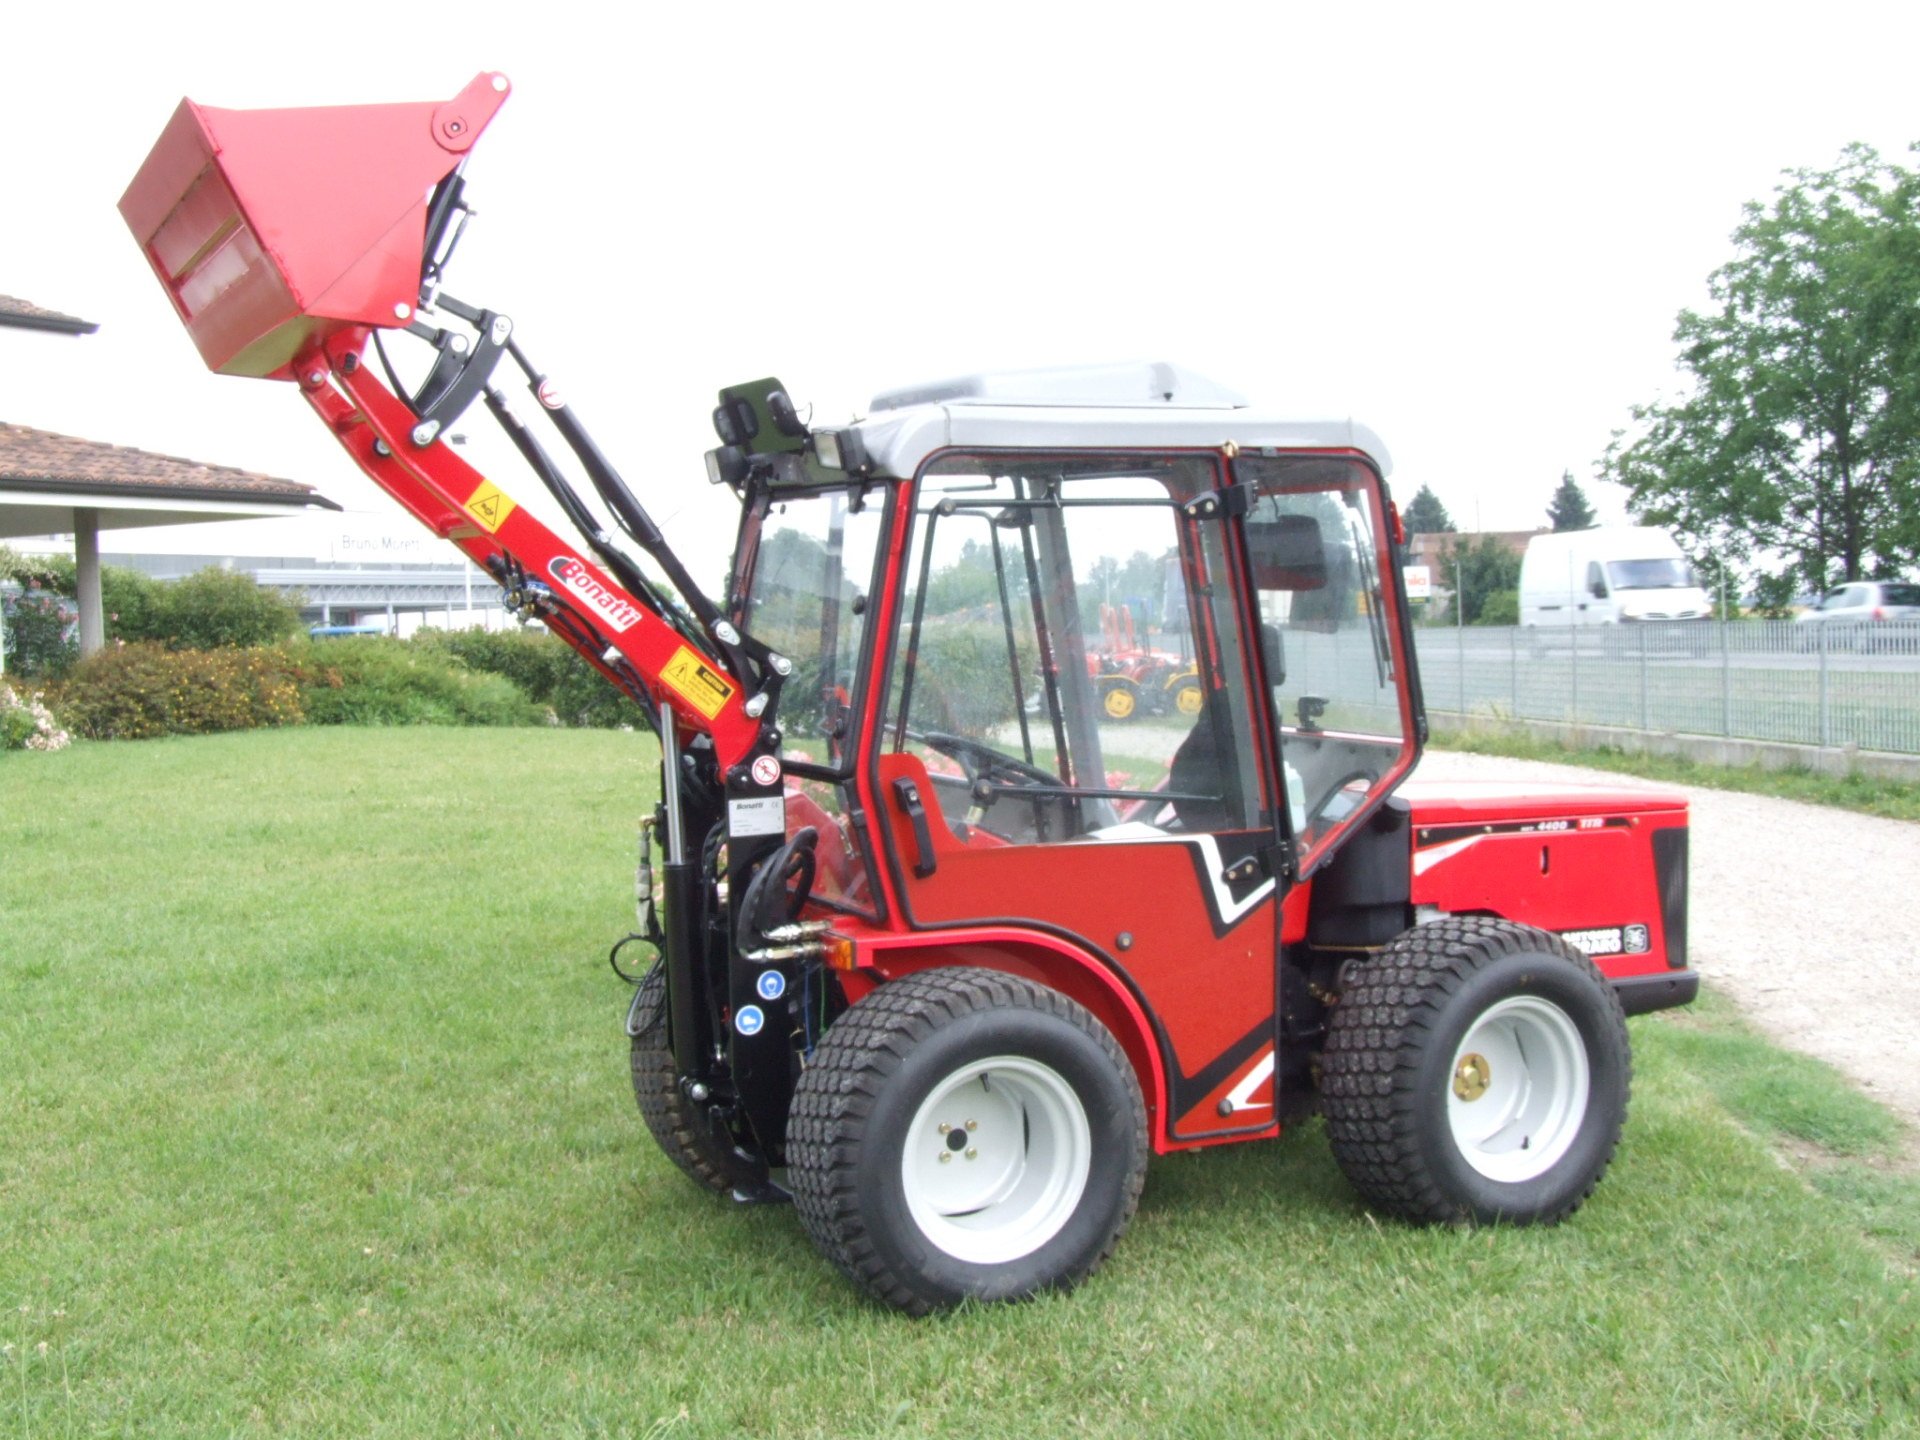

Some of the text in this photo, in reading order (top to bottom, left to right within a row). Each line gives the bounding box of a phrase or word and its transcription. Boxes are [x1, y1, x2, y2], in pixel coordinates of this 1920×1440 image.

[559, 561, 640, 627] Bonatti
[736, 802, 764, 810] Bonatti
[1537, 821, 1568, 831] 4400
